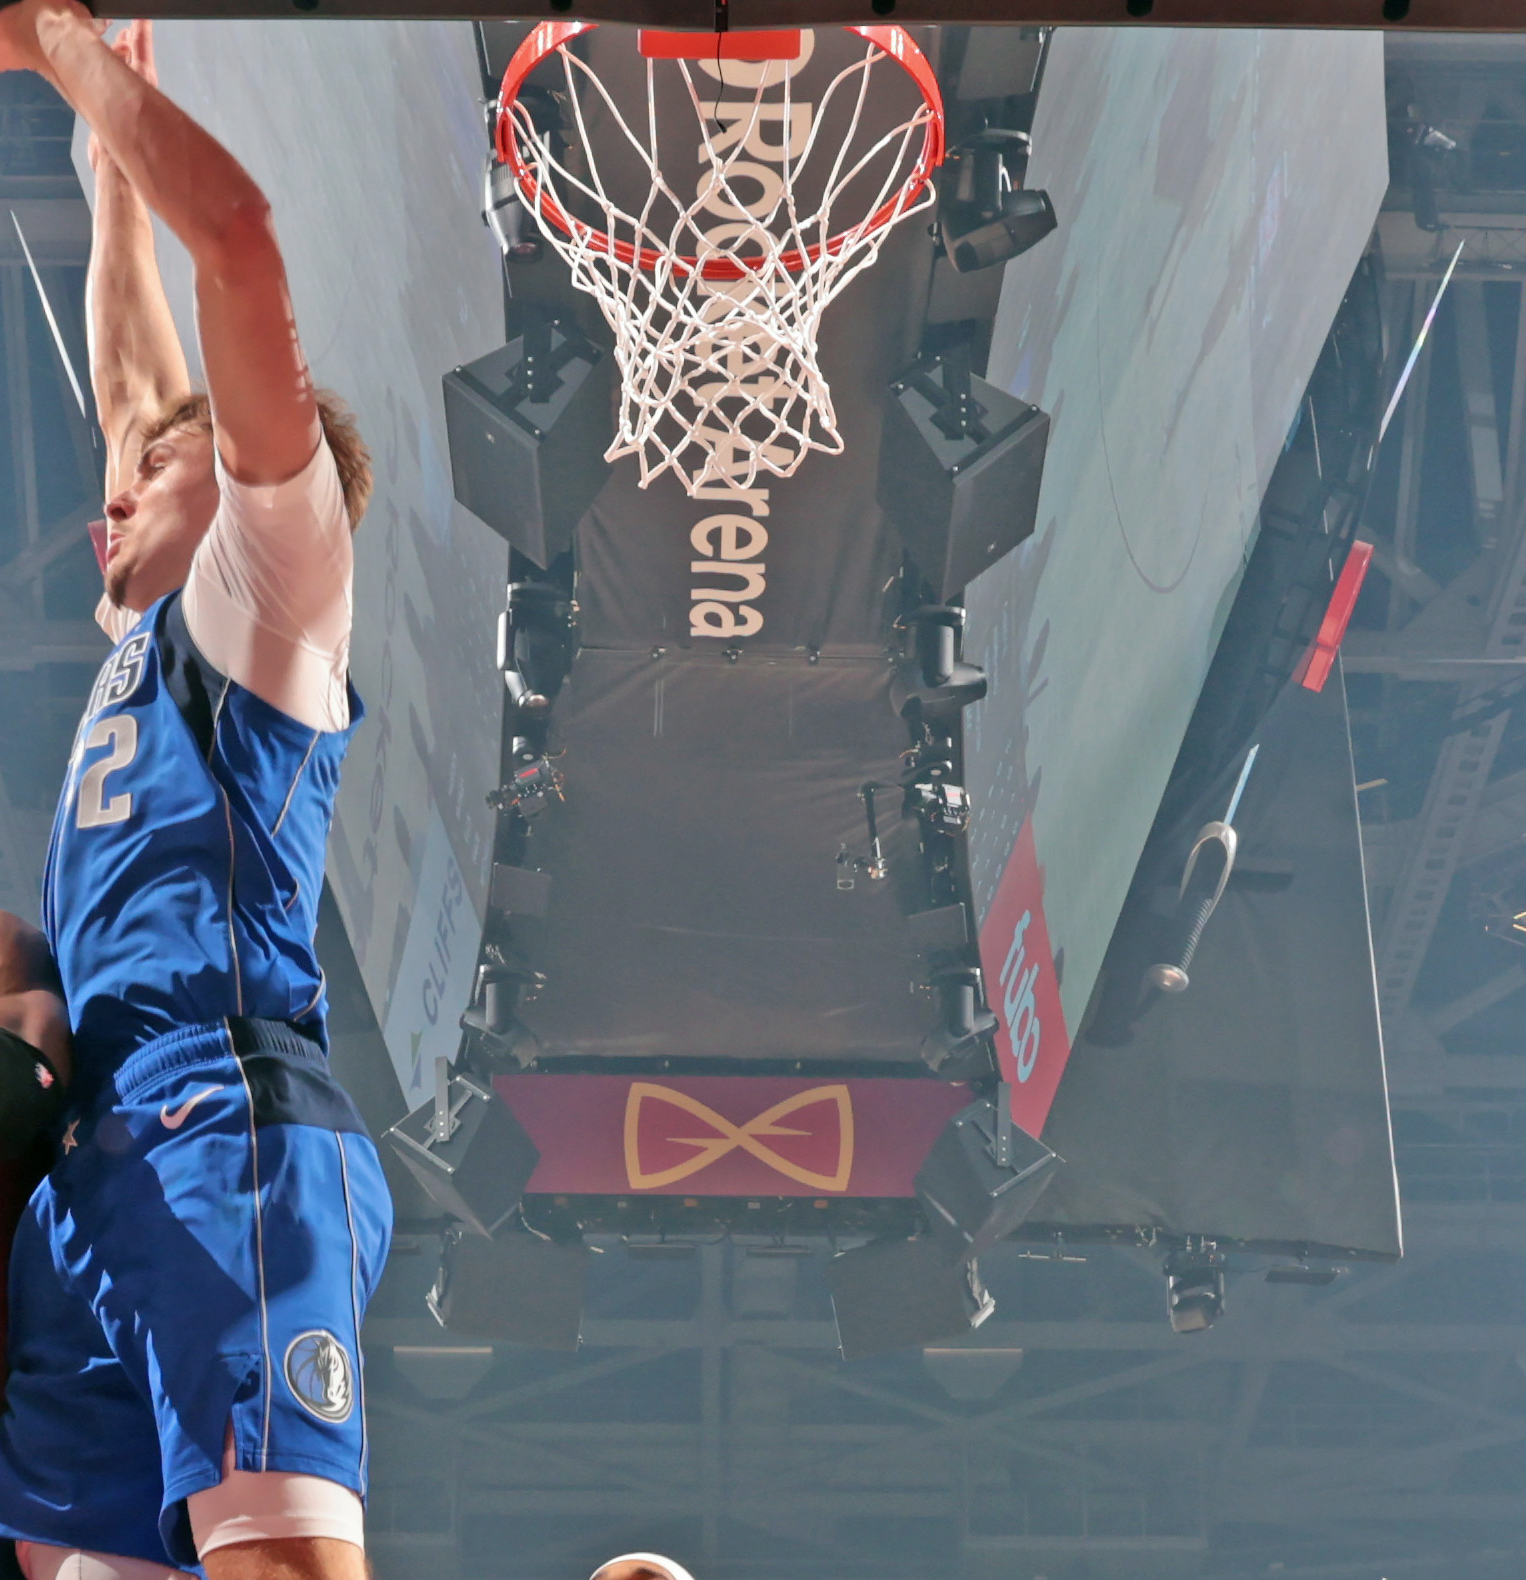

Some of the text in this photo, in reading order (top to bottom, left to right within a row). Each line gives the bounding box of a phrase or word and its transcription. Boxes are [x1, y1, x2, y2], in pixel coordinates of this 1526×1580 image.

[688, 416, 795, 638] Arena
[77, 715, 137, 828] 2
[422, 860, 462, 1026] CLIFFS
[1000, 910, 1040, 1082] fubo
